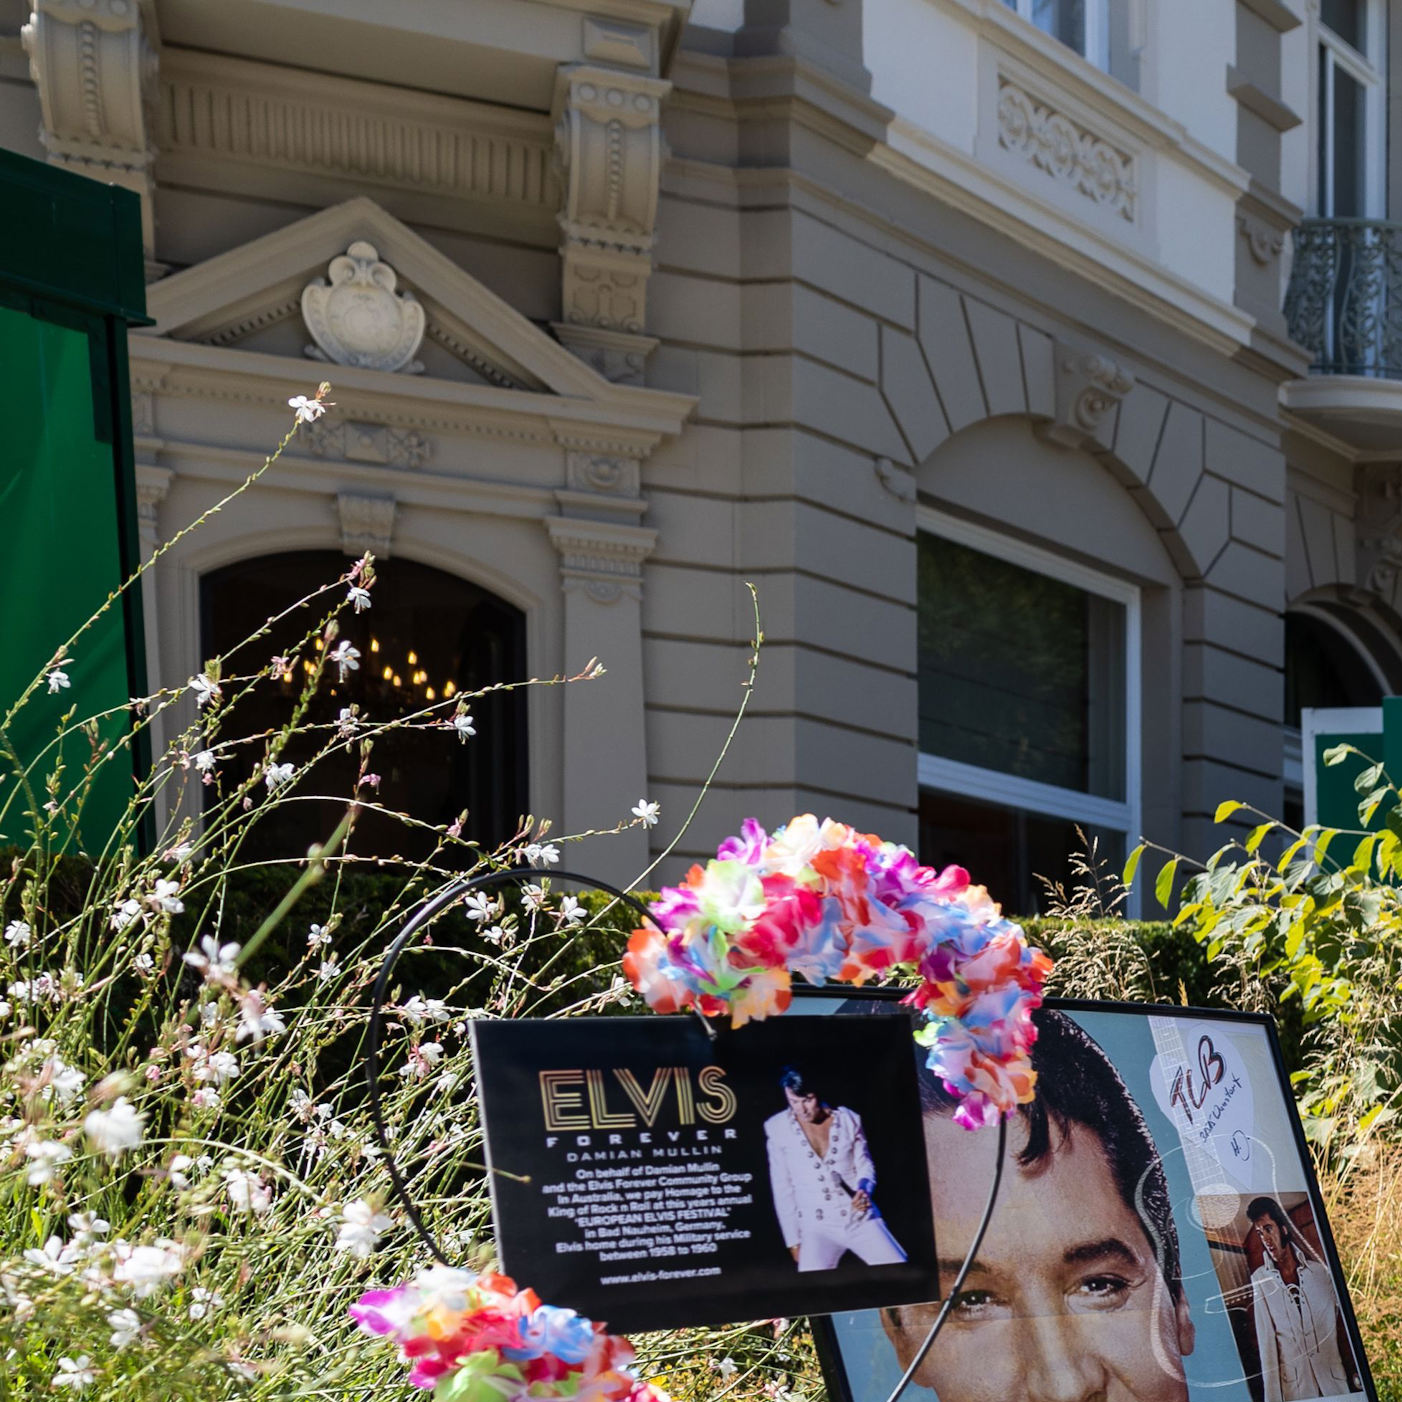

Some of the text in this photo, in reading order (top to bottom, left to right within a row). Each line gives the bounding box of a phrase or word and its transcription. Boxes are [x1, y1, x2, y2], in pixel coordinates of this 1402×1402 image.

[539, 1066, 737, 1131] ELVIS
[546, 1129, 737, 1148] FOREVER
[567, 1146, 723, 1162] DAMIAN MULLIN
[576, 1163, 720, 1179] On behalf of Damian Mullin
[542, 1172, 753, 1194] and the Elvis Forever Community Group
[625, 1192, 642, 1200] we
[644, 1190, 663, 1200] pay
[665, 1186, 710, 1198] Homage
[711, 1186, 722, 1195] to
[723, 1184, 742, 1194] the
[547, 1207, 575, 1218] King
[576, 1206, 589, 1215] of
[591, 1204, 618, 1214] Rock
[630, 1202, 650, 1212] Roll
[653, 1200, 665, 1210] at
[666, 1199, 687, 1209] this
[687, 1197, 715, 1208] years
[717, 1195, 753, 1205] annual
[644, 1211, 676, 1223] ELVIS
[555, 1229, 751, 1253] Elvis home during his Military service
[584, 1229, 596, 1239] in
[597, 1227, 620, 1238] Bad
[599, 1243, 718, 1261] between 1958 to 1960
[600, 1266, 722, 1285] www.elvis-forever.com
